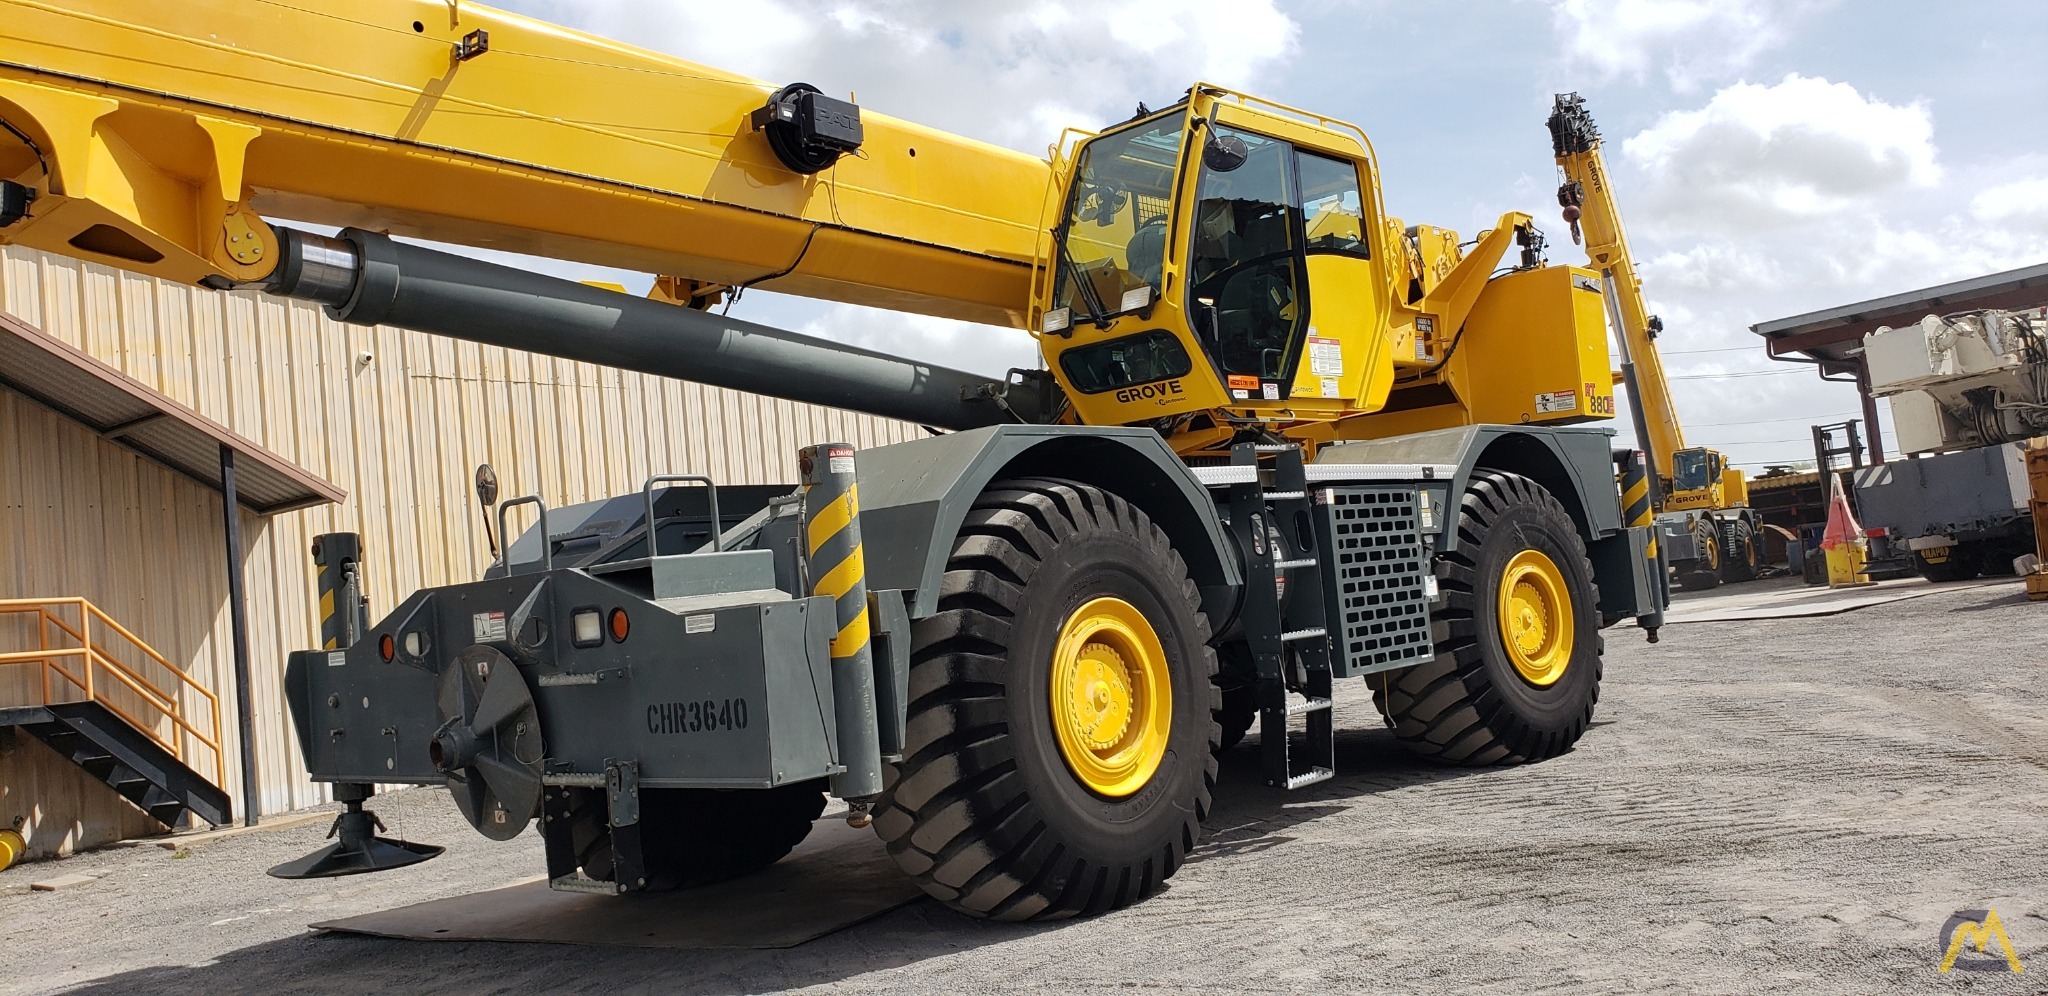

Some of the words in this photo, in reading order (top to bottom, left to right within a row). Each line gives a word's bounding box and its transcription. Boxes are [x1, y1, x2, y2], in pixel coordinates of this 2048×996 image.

[815, 108, 859, 130] PAT
[1587, 160, 1602, 194] GROVE
[1116, 380, 1183, 403] GROVE
[1585, 383, 1595, 397] RT
[1676, 494, 1708, 503] GROVE
[647, 698, 748, 734] CHR3640
